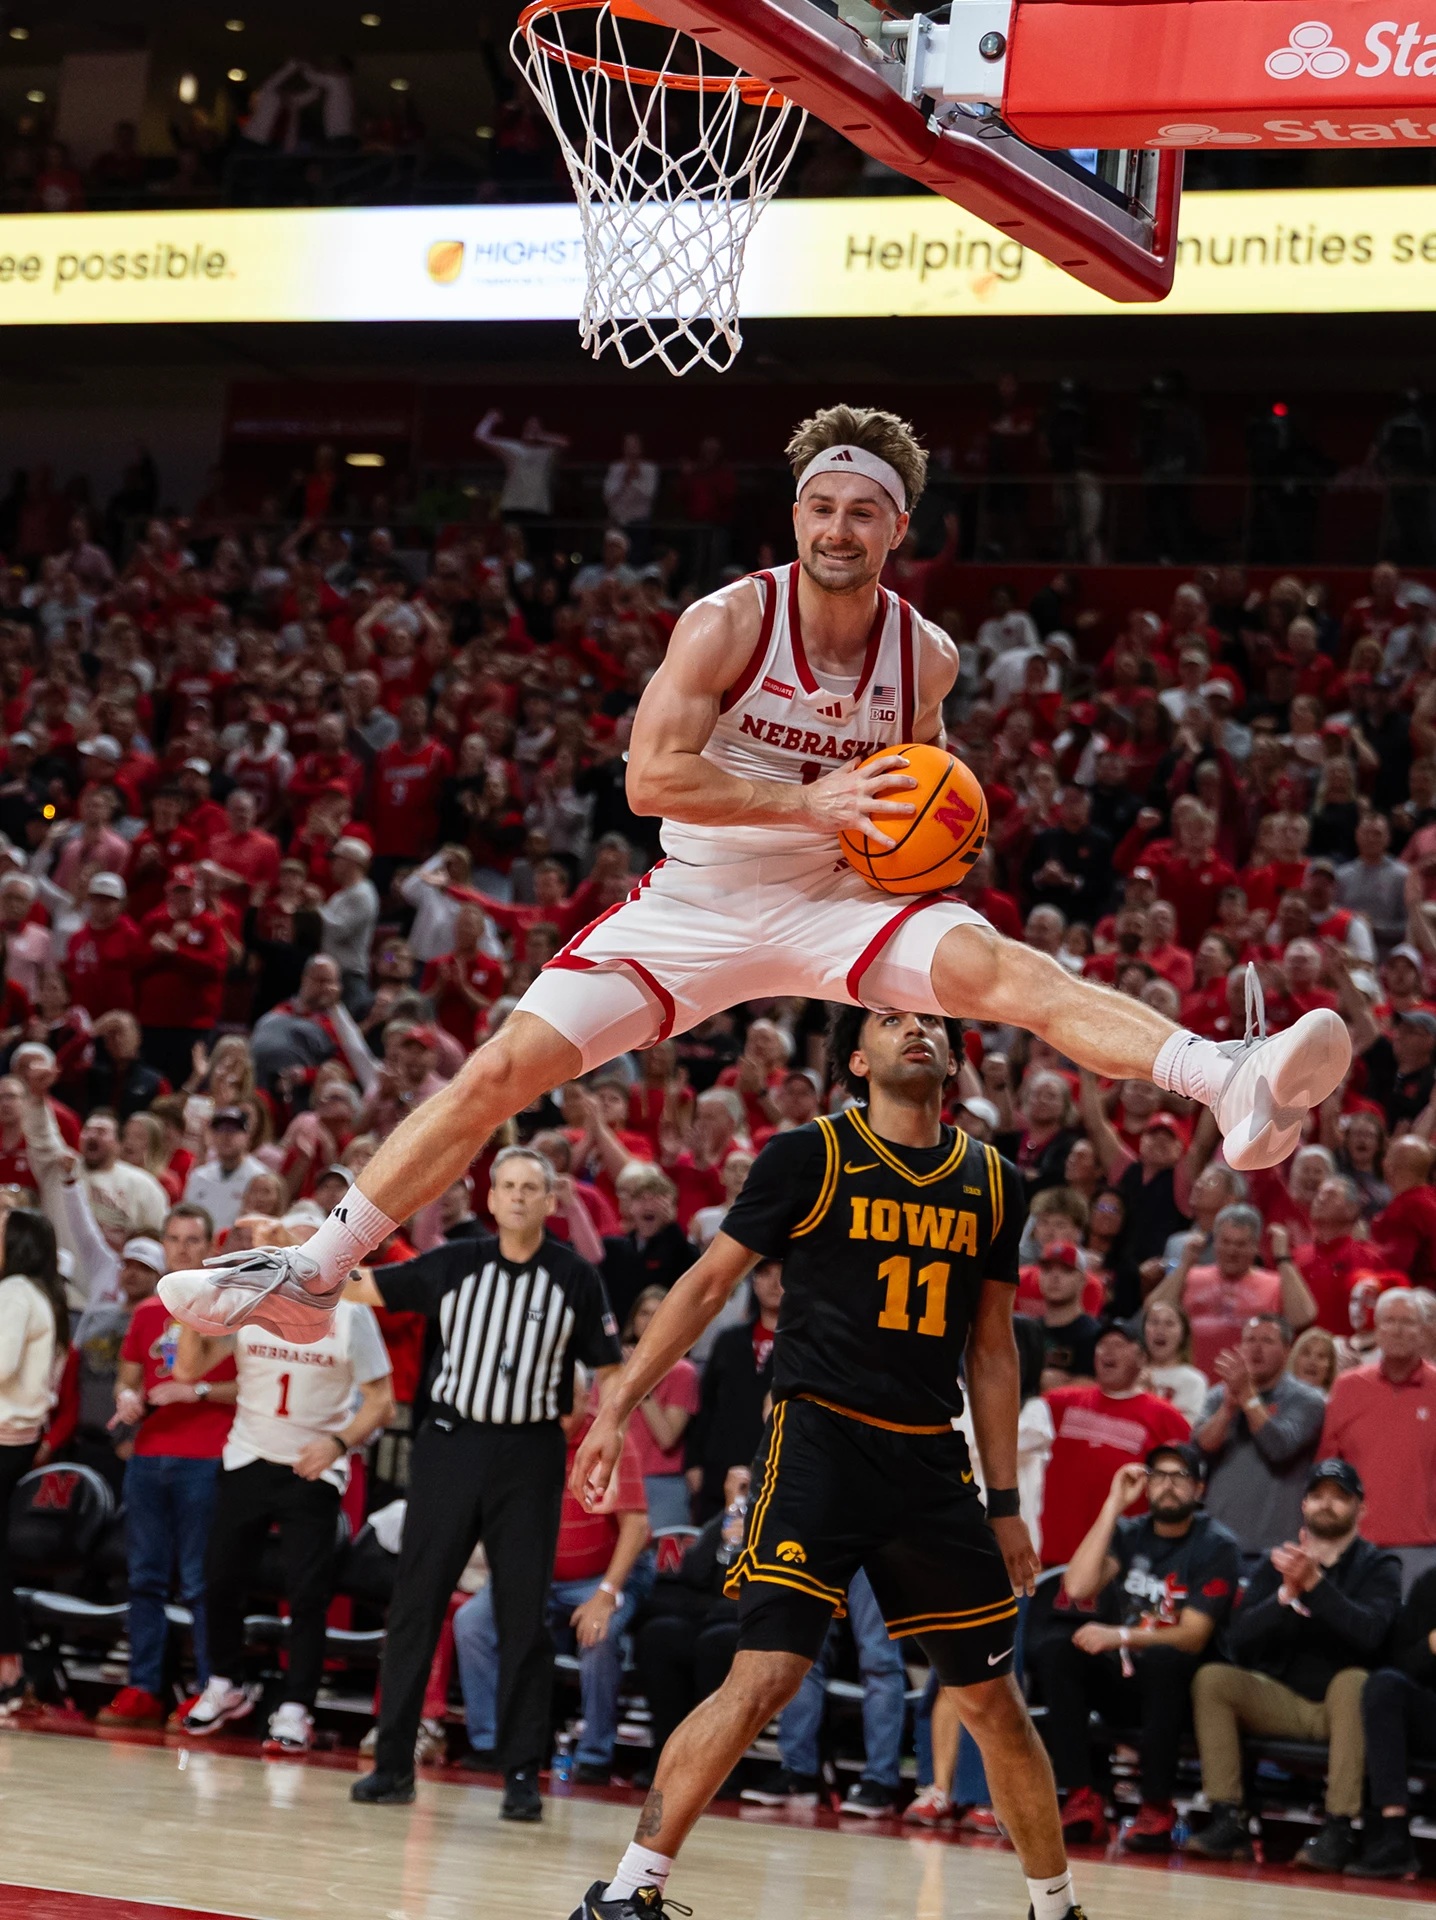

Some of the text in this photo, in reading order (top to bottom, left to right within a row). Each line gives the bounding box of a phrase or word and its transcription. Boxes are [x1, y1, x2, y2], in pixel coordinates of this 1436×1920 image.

[53, 243, 237, 295] possible.
[846, 230, 1024, 282] Helping
[763, 680, 793, 696] GRADUATE
[849, 1197, 978, 1257] IOWA
[877, 1255, 951, 1337] 11
[247, 1344, 335, 1368] NEBRASKA
[276, 1372, 290, 1416] 1
[32, 1472, 80, 1509] N
